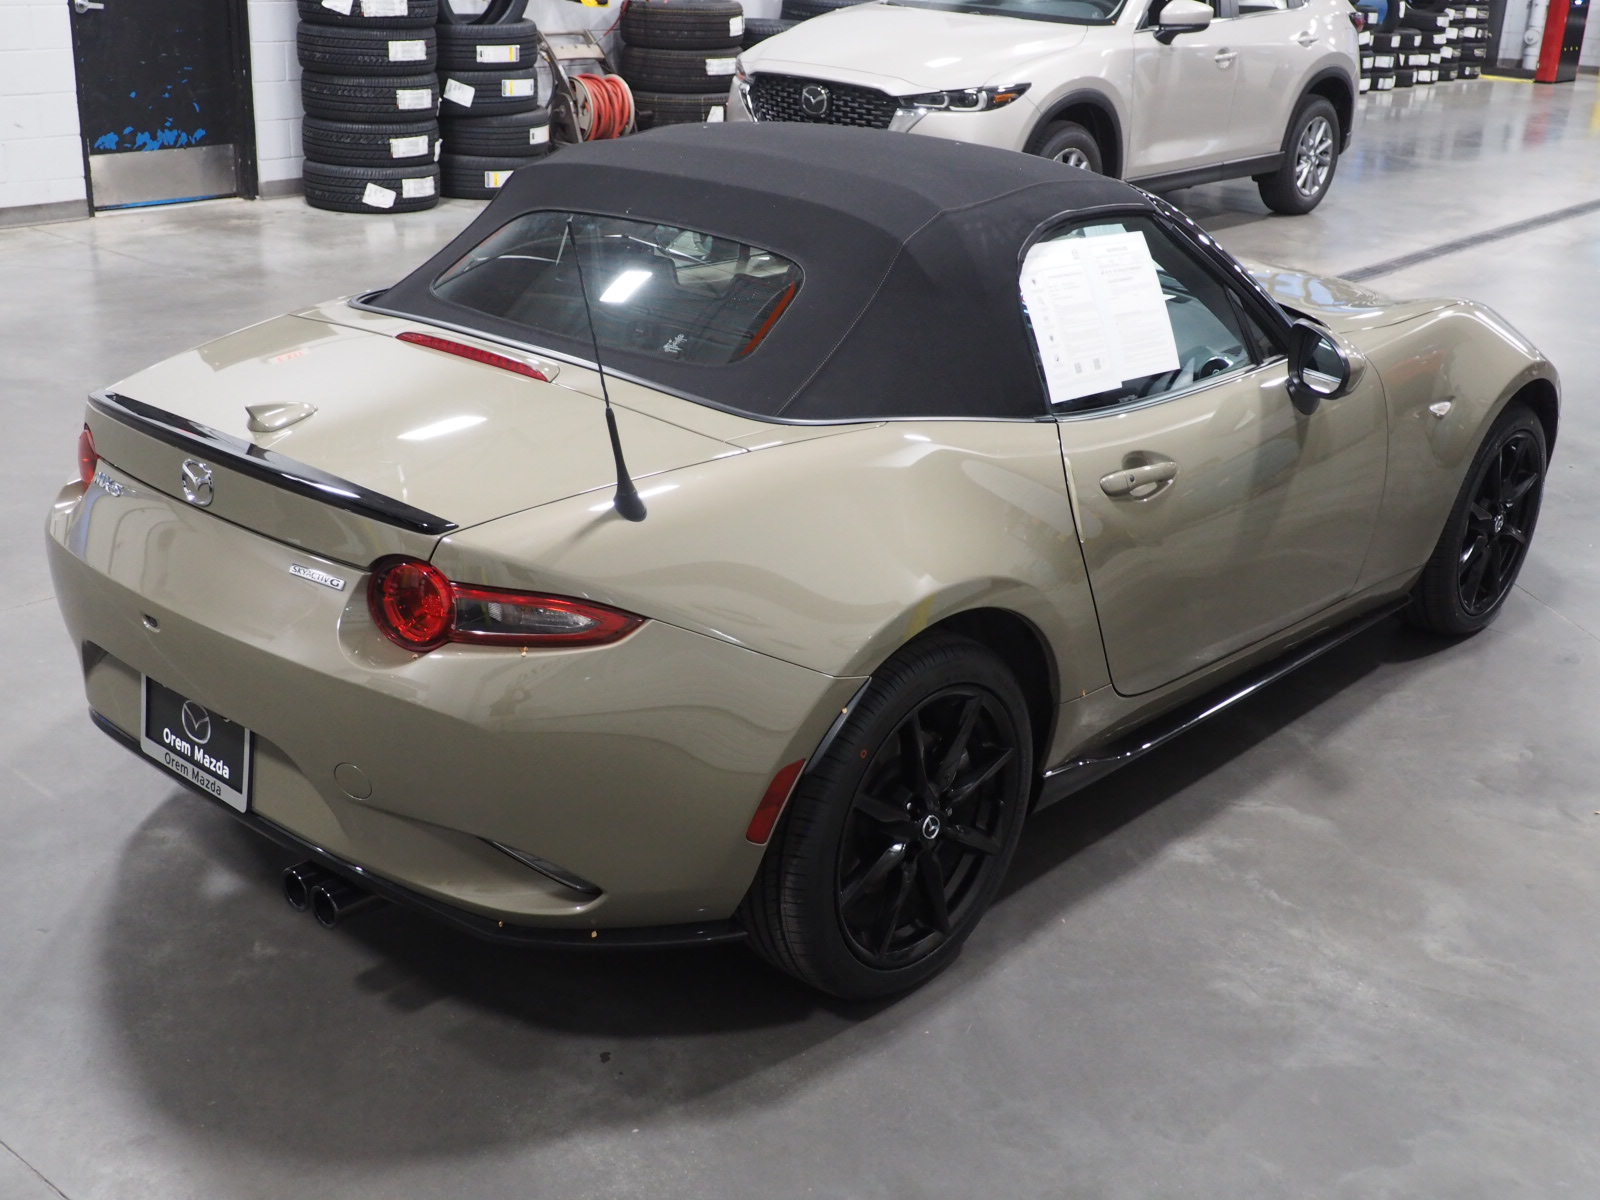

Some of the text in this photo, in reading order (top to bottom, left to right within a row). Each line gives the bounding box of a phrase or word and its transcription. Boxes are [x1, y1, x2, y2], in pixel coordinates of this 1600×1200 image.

[163, 727, 230, 779] Orem Mazda
[164, 752, 222, 796] Orem Mazda
